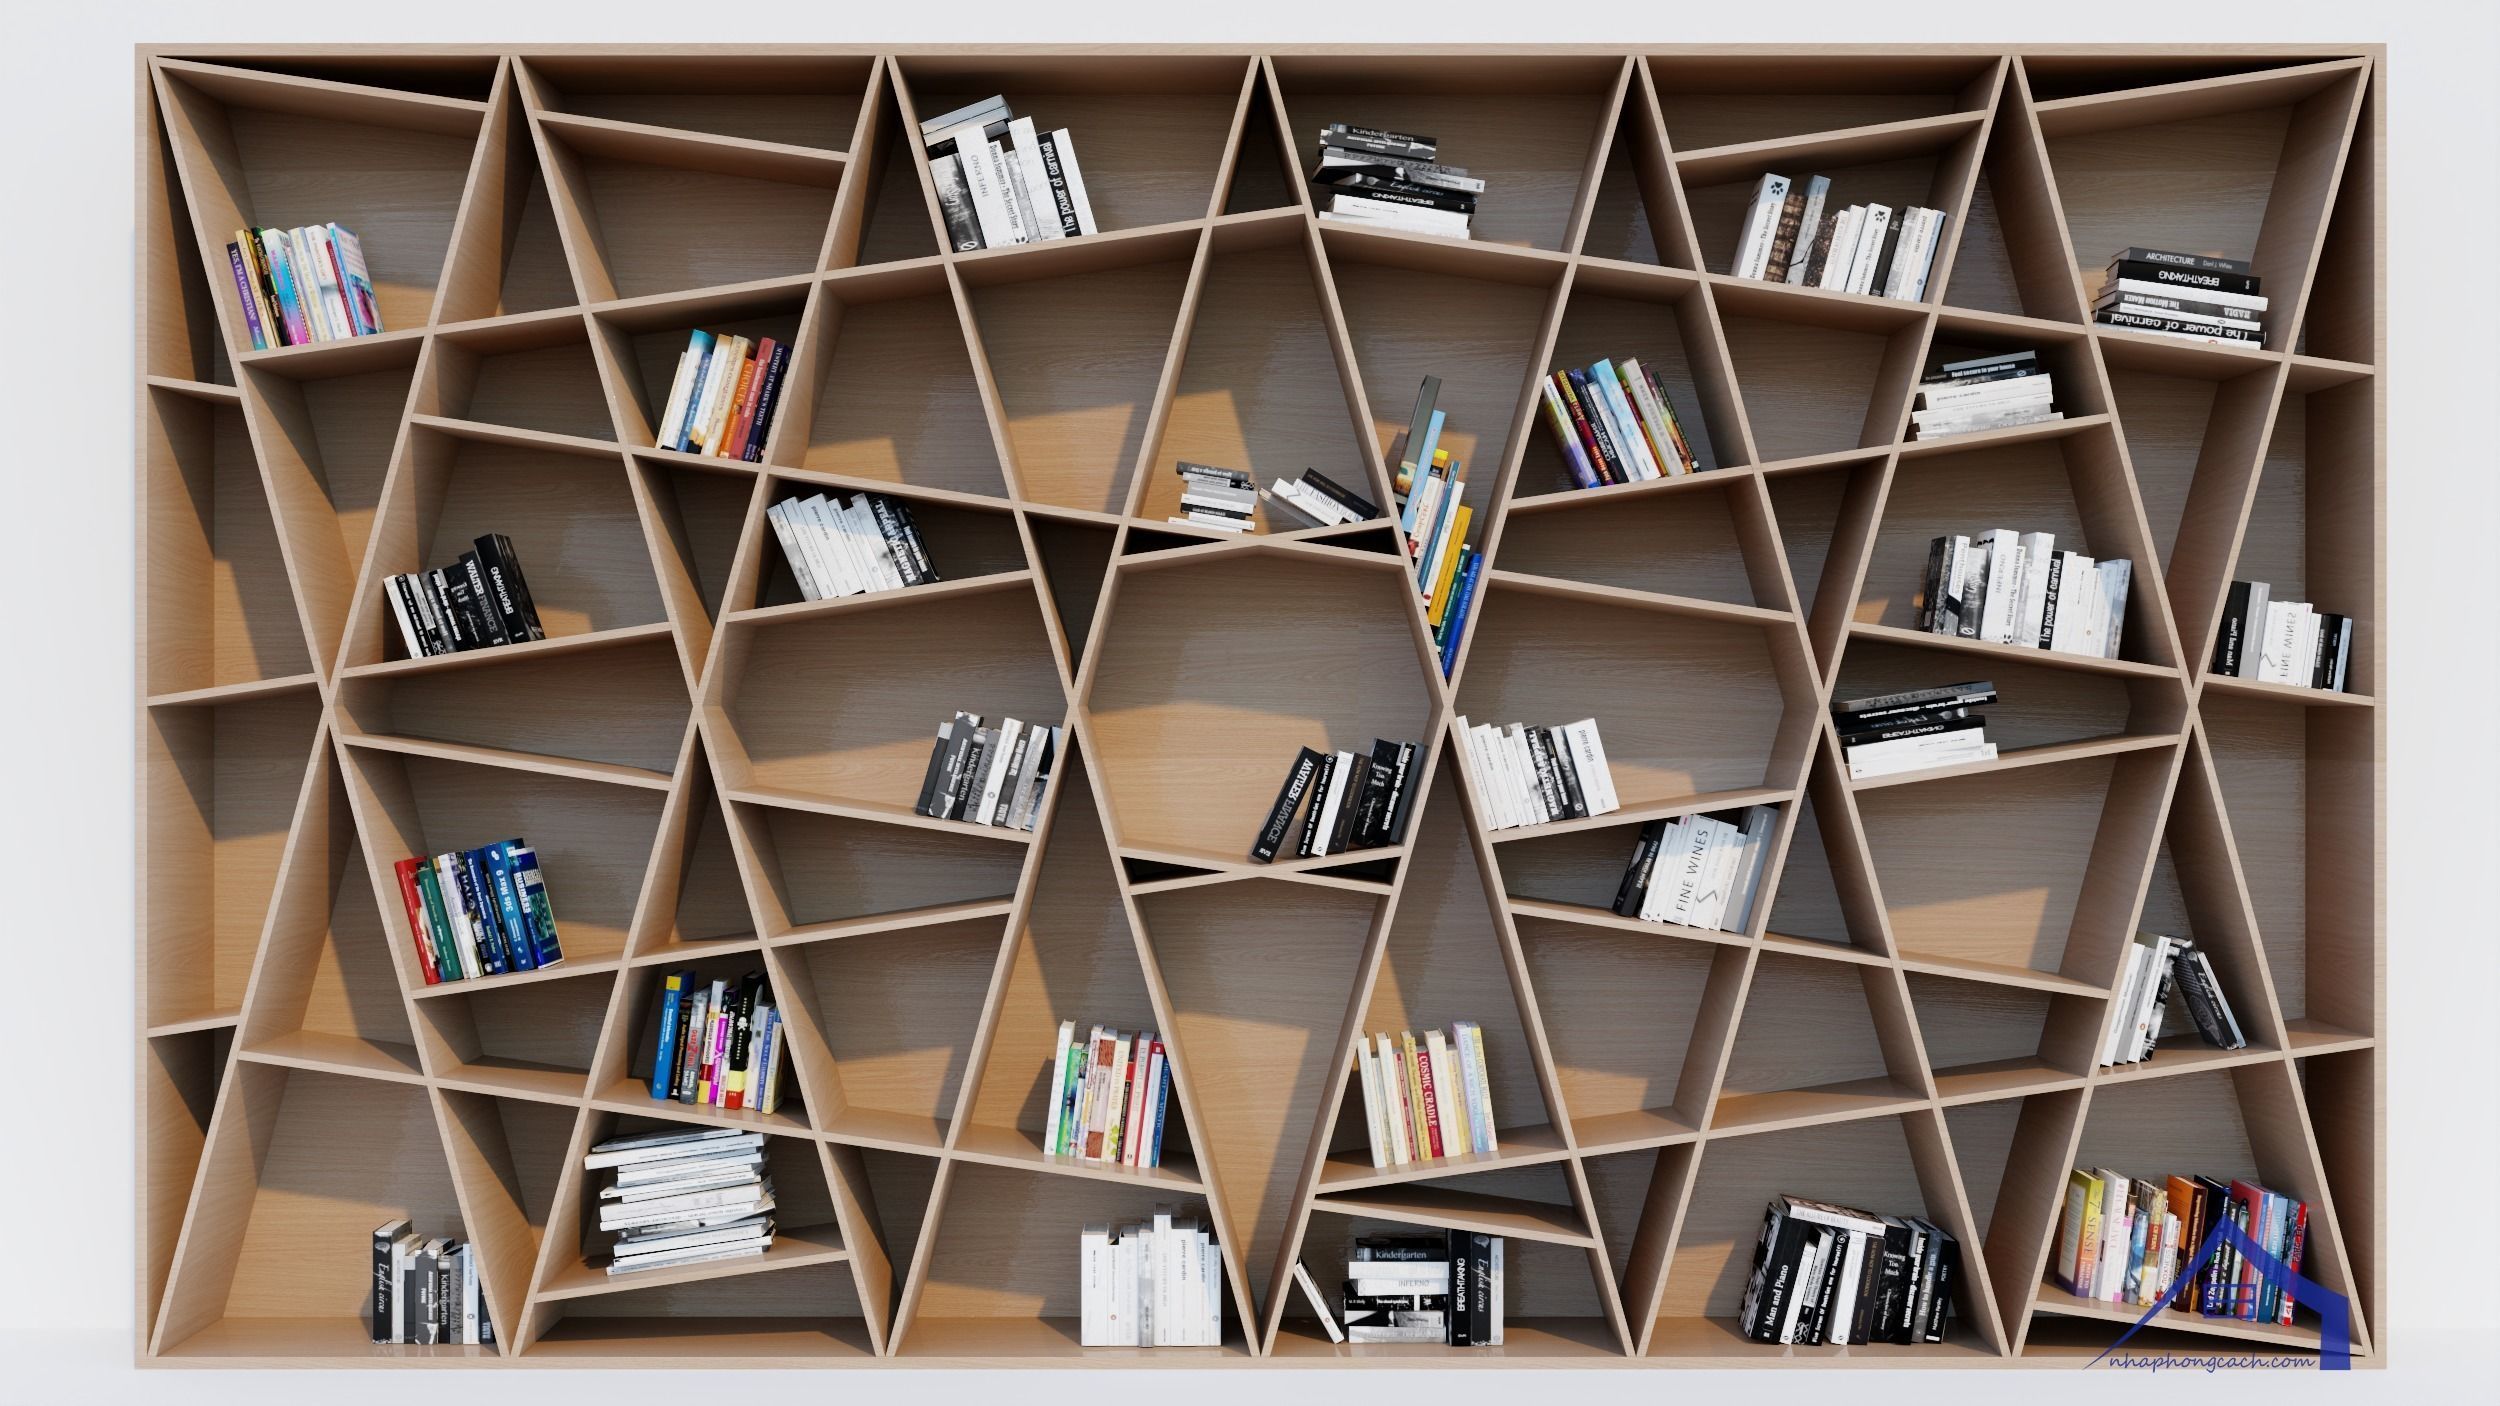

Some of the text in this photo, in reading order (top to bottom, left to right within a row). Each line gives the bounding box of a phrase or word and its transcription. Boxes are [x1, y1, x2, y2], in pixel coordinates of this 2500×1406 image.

[1352, 128, 1414, 142] Kindergarten
[1040, 142, 1076, 232] The power of carnival
[1372, 192, 1434, 206] BREATHTAKING
[2146, 252, 2195, 265] ARCHITECTURE
[2159, 271, 2219, 286] BREATHTAKING
[2111, 313, 2248, 341] The power of carnival
[465, 560, 498, 633] WALTER FINANCE
[491, 566, 514, 615] BREATHTAKING
[2039, 558, 2062, 643] The power of carnival
[959, 748, 978, 800] Kindergarten
[500, 881, 510, 895] Max
[1676, 830, 1708, 912] FINE WINES
[505, 896, 513, 912] 3ds
[2198, 972, 2215, 999] English
[1419, 1056, 1437, 1126] COSMIC CRADLE
[1376, 1250, 1427, 1260] Kindergarten
[1473, 1258, 1489, 1289] English
[373, 1263, 391, 1312] English circus
[438, 1274, 448, 1325] Kindergarten
[1457, 1258, 1466, 1312] BREATHTAKING
[1765, 1265, 1789, 1327] Man and Piano
